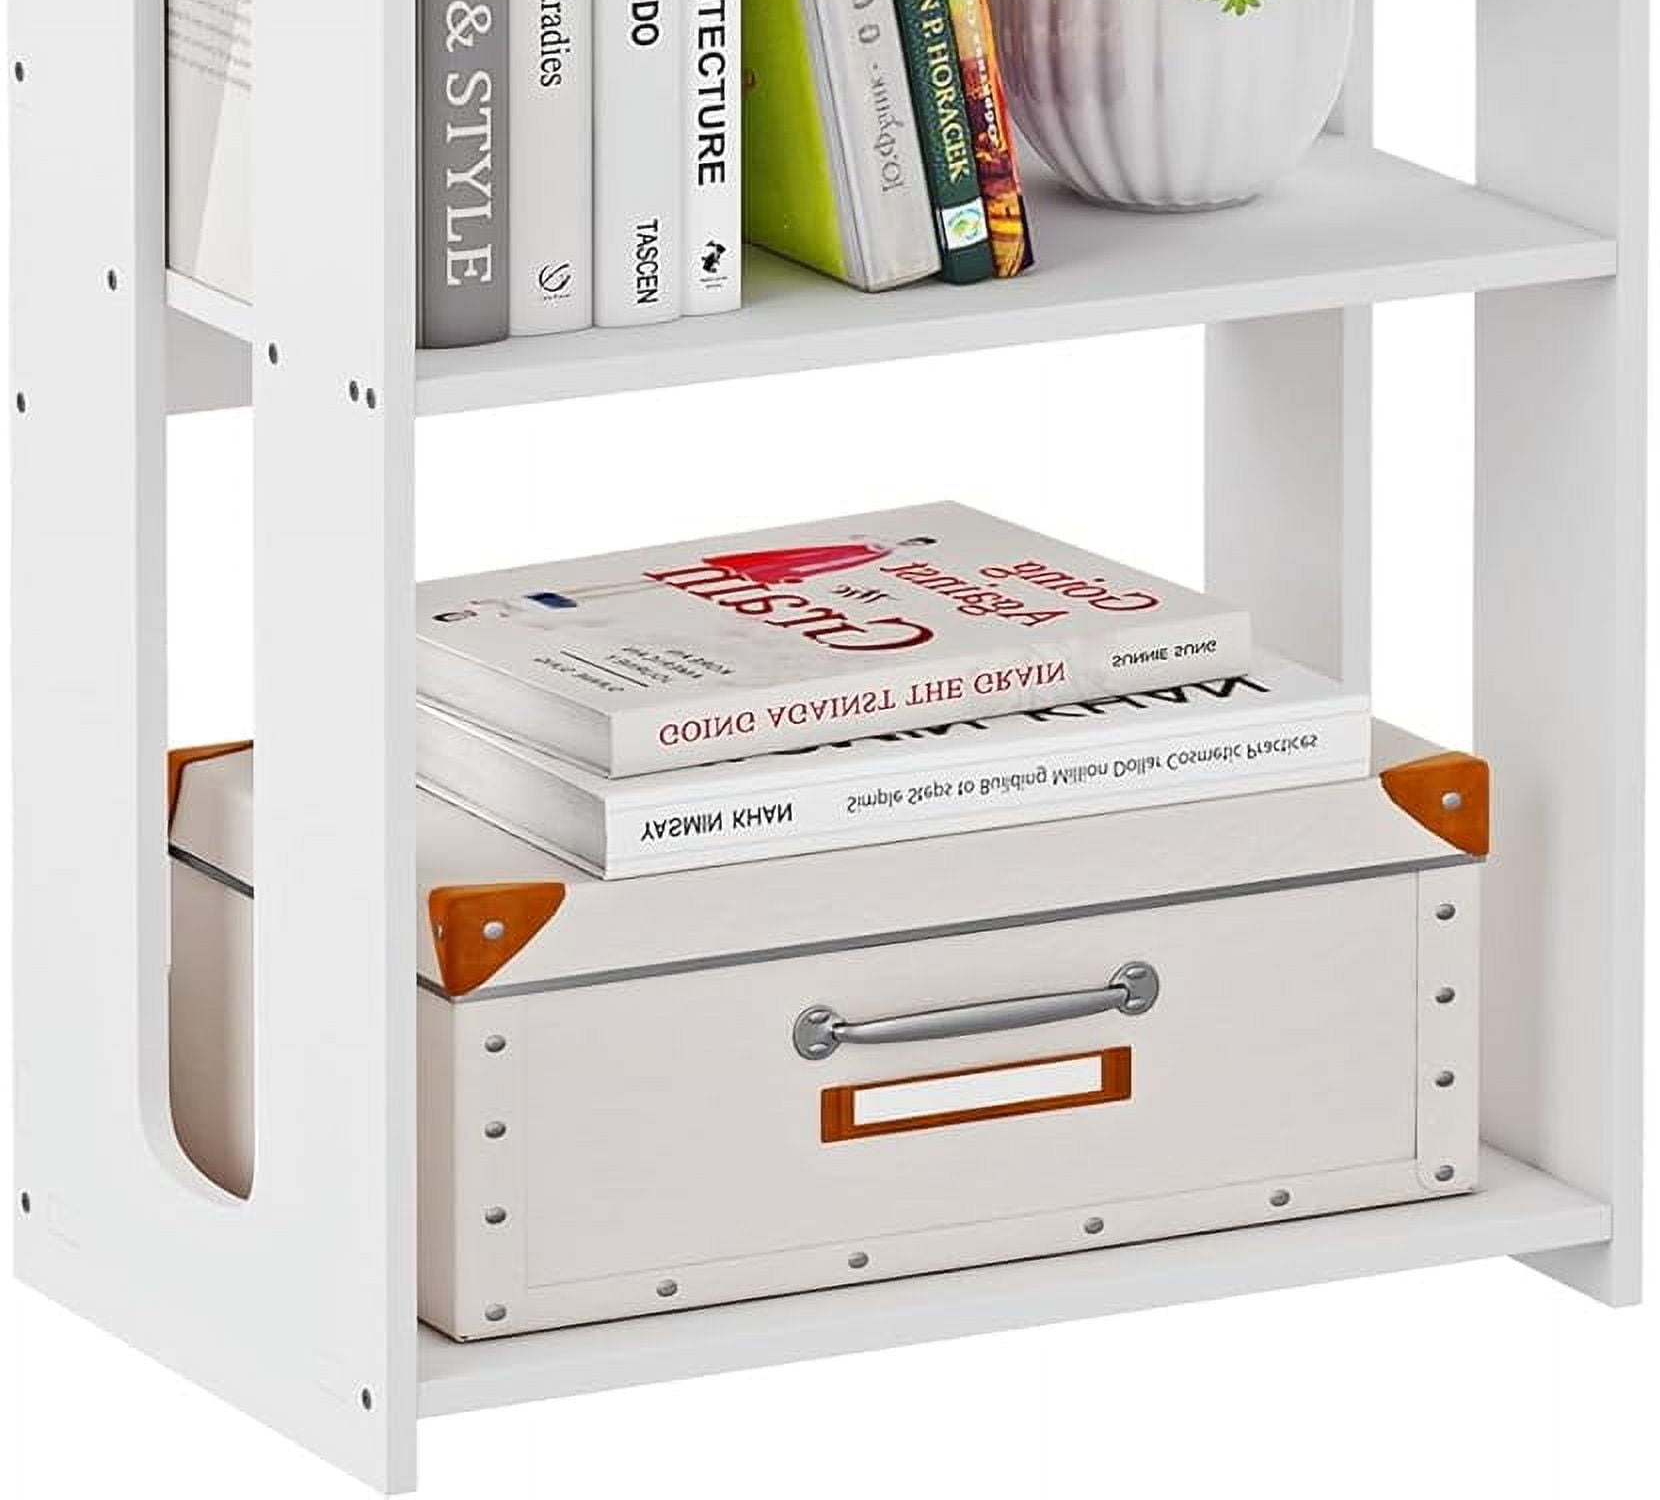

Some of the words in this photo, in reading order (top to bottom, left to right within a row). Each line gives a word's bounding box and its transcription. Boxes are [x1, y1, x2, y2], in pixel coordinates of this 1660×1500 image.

[445, 0, 492, 52] &
[857, 22, 881, 45] О
[926, 41, 970, 184] HORACEK
[445, 69, 492, 286] STYLE
[635, 218, 659, 305] TASCEN
